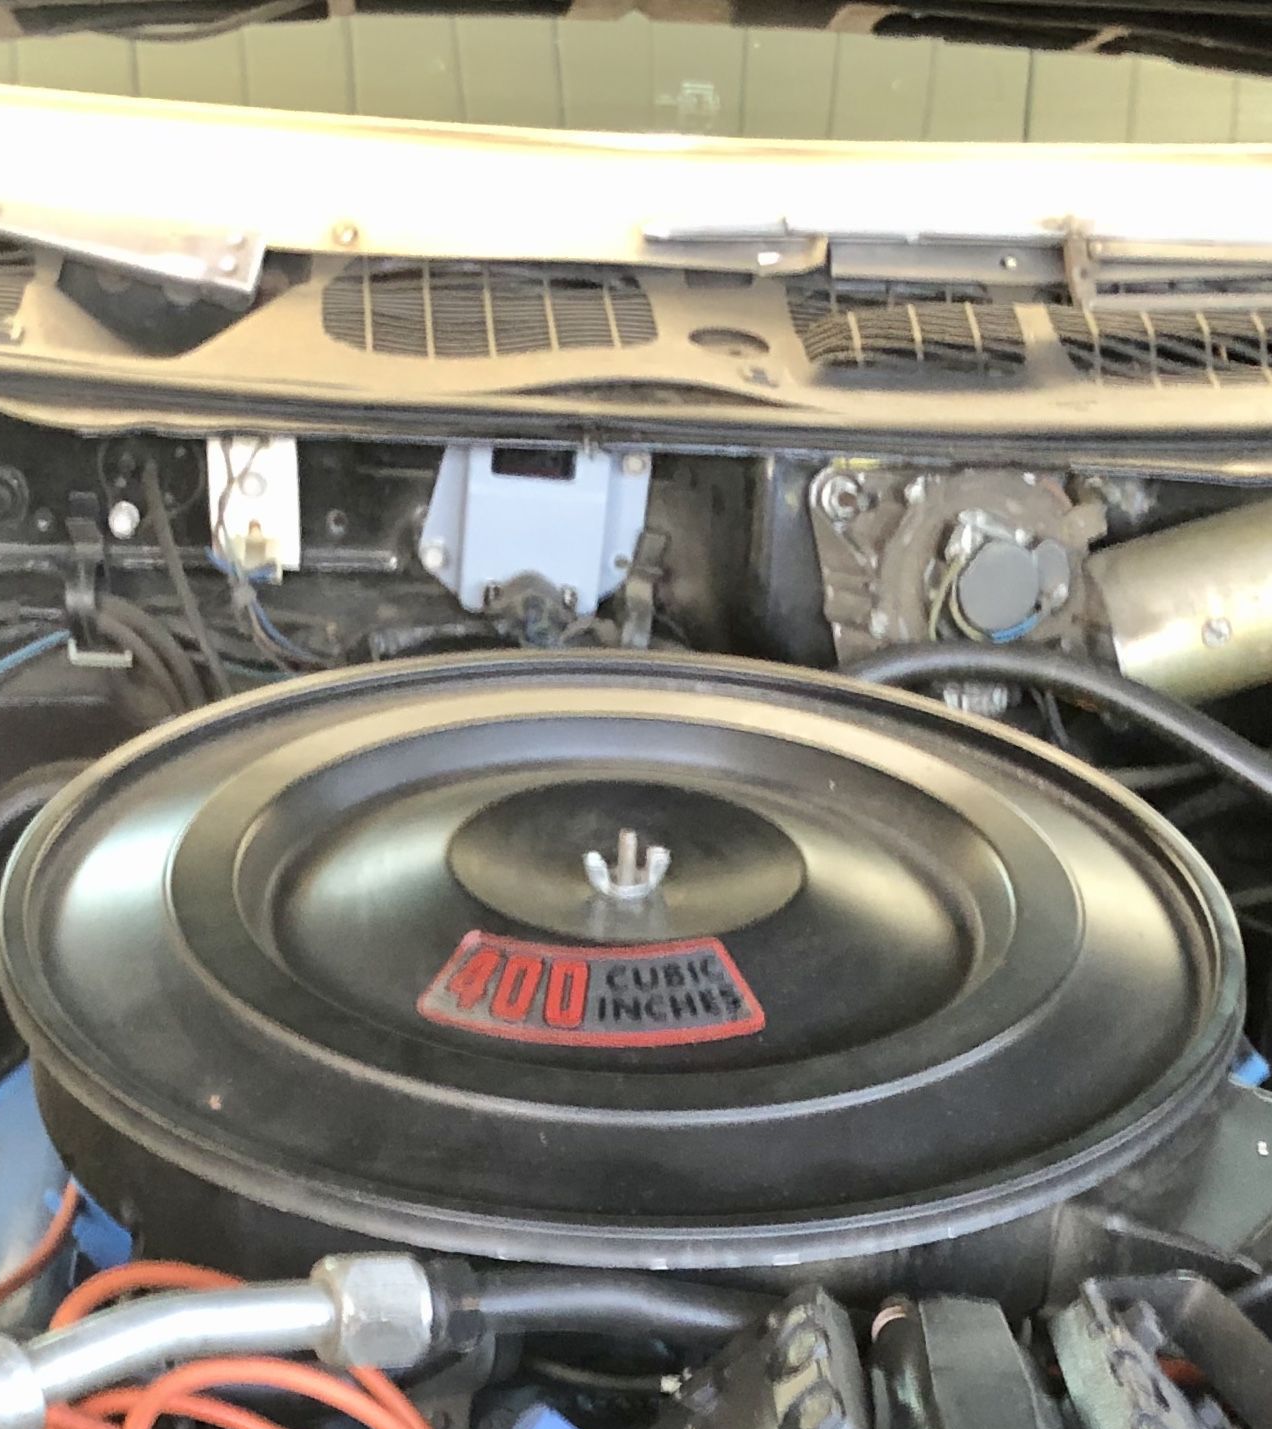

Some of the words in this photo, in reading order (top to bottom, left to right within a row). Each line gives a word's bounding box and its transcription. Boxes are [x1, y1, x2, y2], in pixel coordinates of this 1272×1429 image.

[446, 948, 591, 1029] 400
[604, 956, 726, 992] CUBIC
[596, 987, 744, 1024] INCHES
